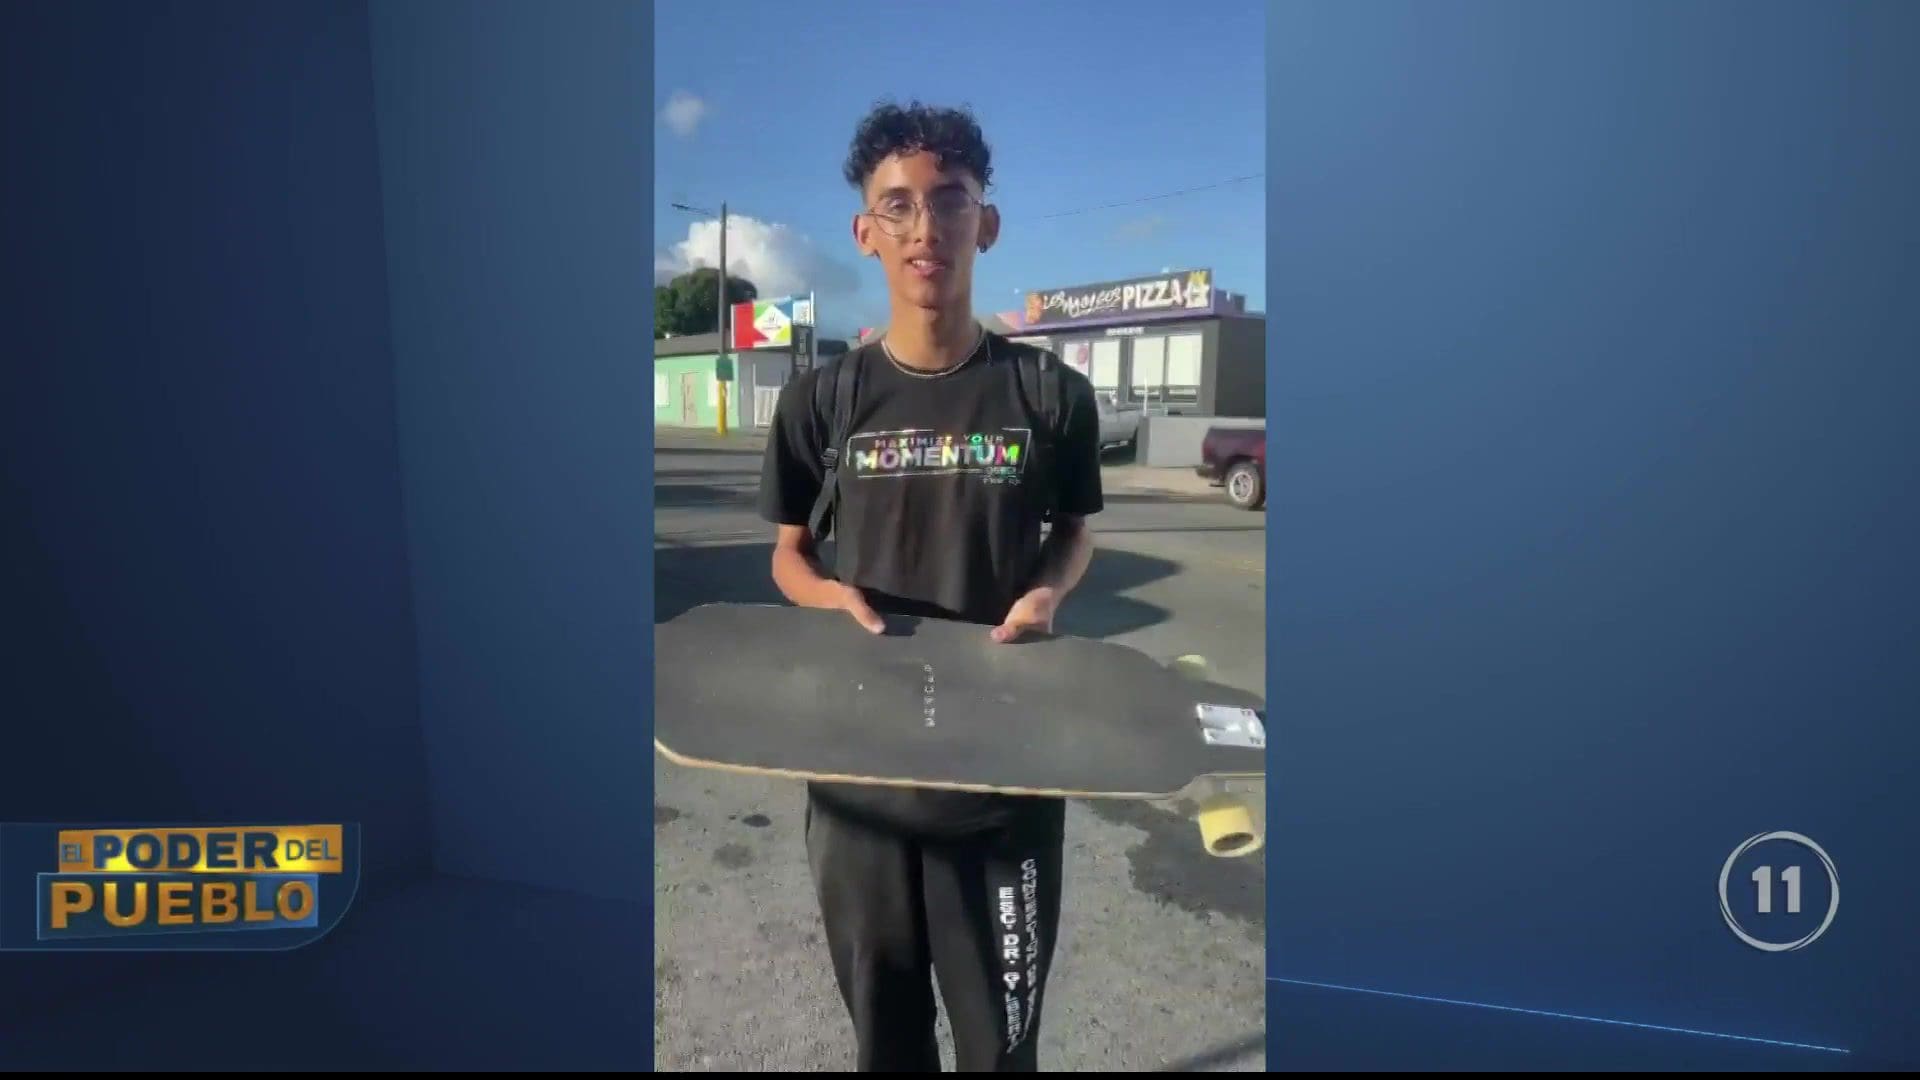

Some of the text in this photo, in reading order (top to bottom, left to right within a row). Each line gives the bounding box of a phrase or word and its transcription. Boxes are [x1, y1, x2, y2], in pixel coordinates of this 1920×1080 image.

[1122, 278, 1184, 311] PIZZA
[874, 432, 1004, 449] MAXIMIZE YOUR
[855, 444, 1020, 471] MOMENTUM
